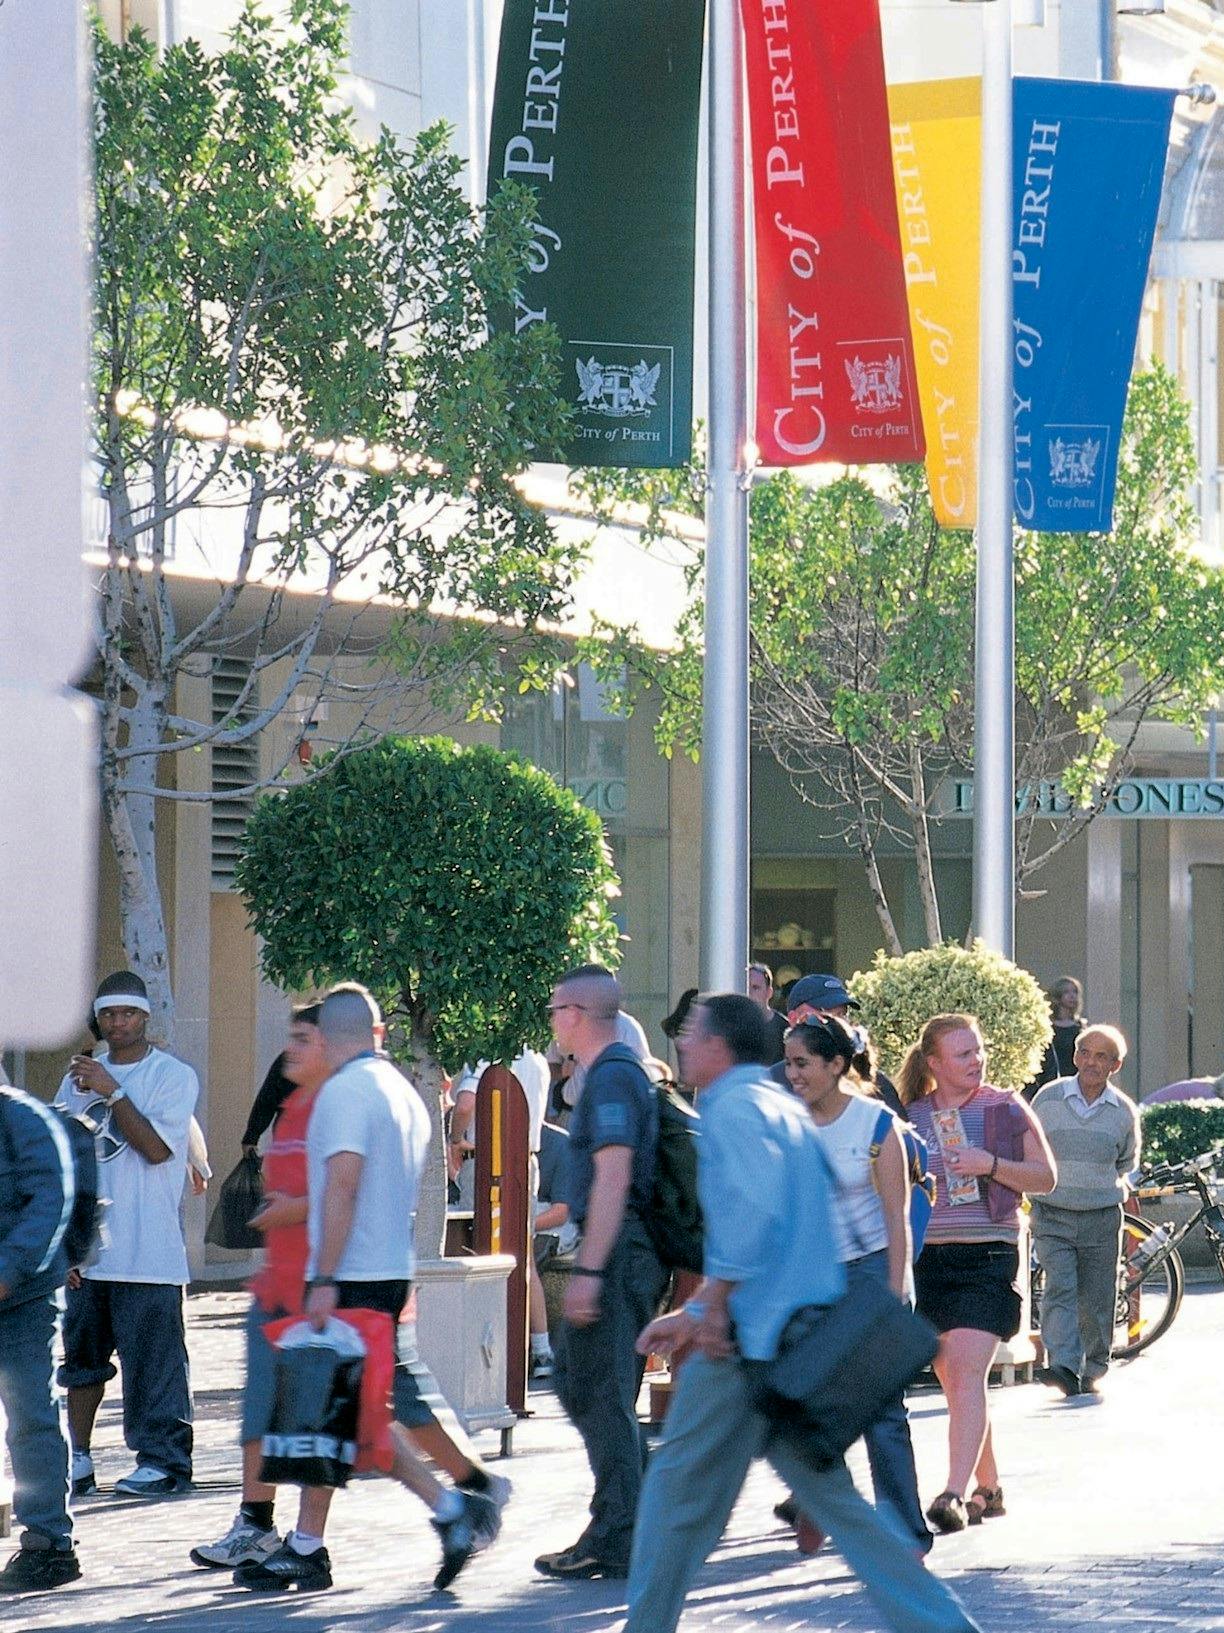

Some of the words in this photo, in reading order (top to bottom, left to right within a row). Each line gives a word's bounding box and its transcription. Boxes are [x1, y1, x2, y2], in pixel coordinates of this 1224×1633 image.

[762, 0, 805, 190] PERTH
[775, 212, 820, 279] of
[890, 121, 937, 287] PERTH
[1012, 119, 1061, 289] PERTH
[774, 303, 826, 456] CITY
[915, 308, 953, 366] of
[1013, 318, 1042, 368] of
[605, 428, 619, 442] of
[622, 427, 660, 441] PERTH
[934, 385, 966, 517] CITY
[1013, 385, 1035, 520] CITY
